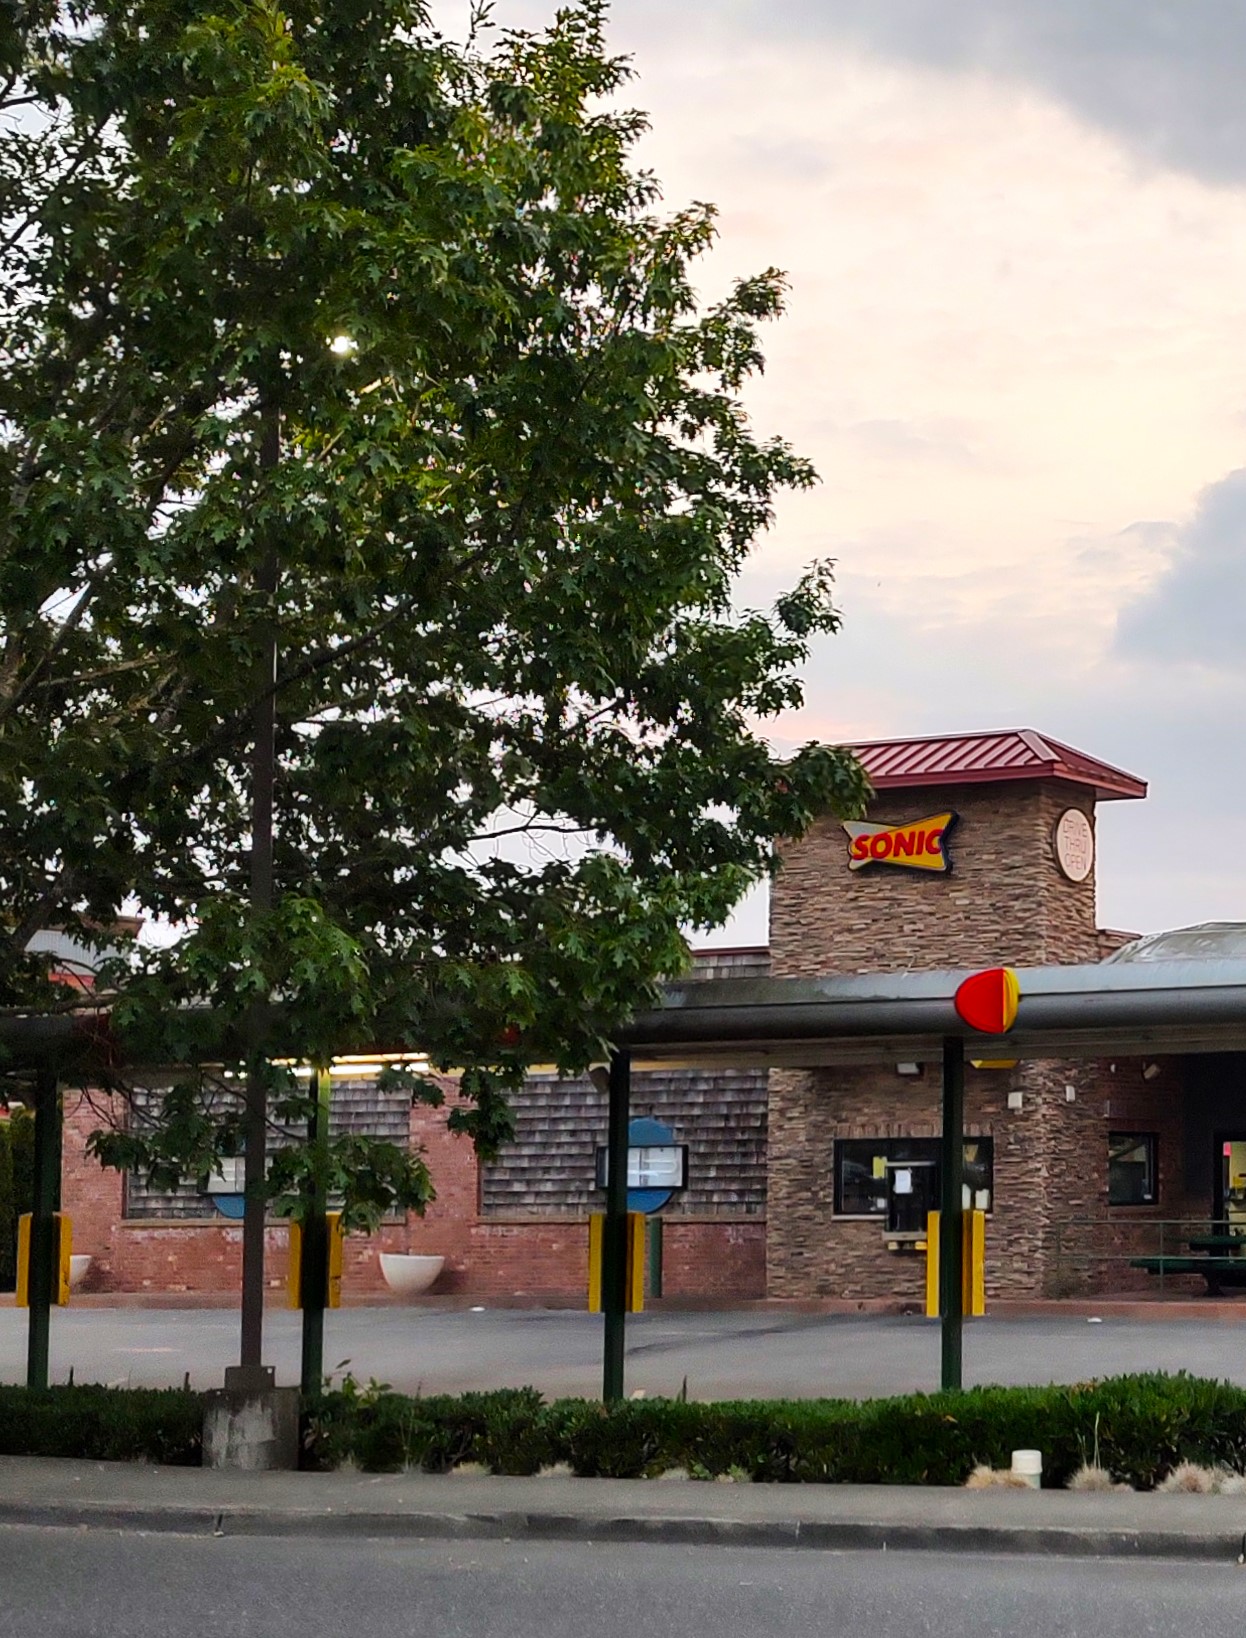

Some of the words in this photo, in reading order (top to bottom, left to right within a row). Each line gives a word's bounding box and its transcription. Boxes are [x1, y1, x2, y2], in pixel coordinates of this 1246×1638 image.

[1063, 818, 1088, 838] DRIVE
[852, 829, 944, 860] SONIC
[1064, 836, 1087, 854] THRU
[1065, 853, 1087, 871] OPEN
